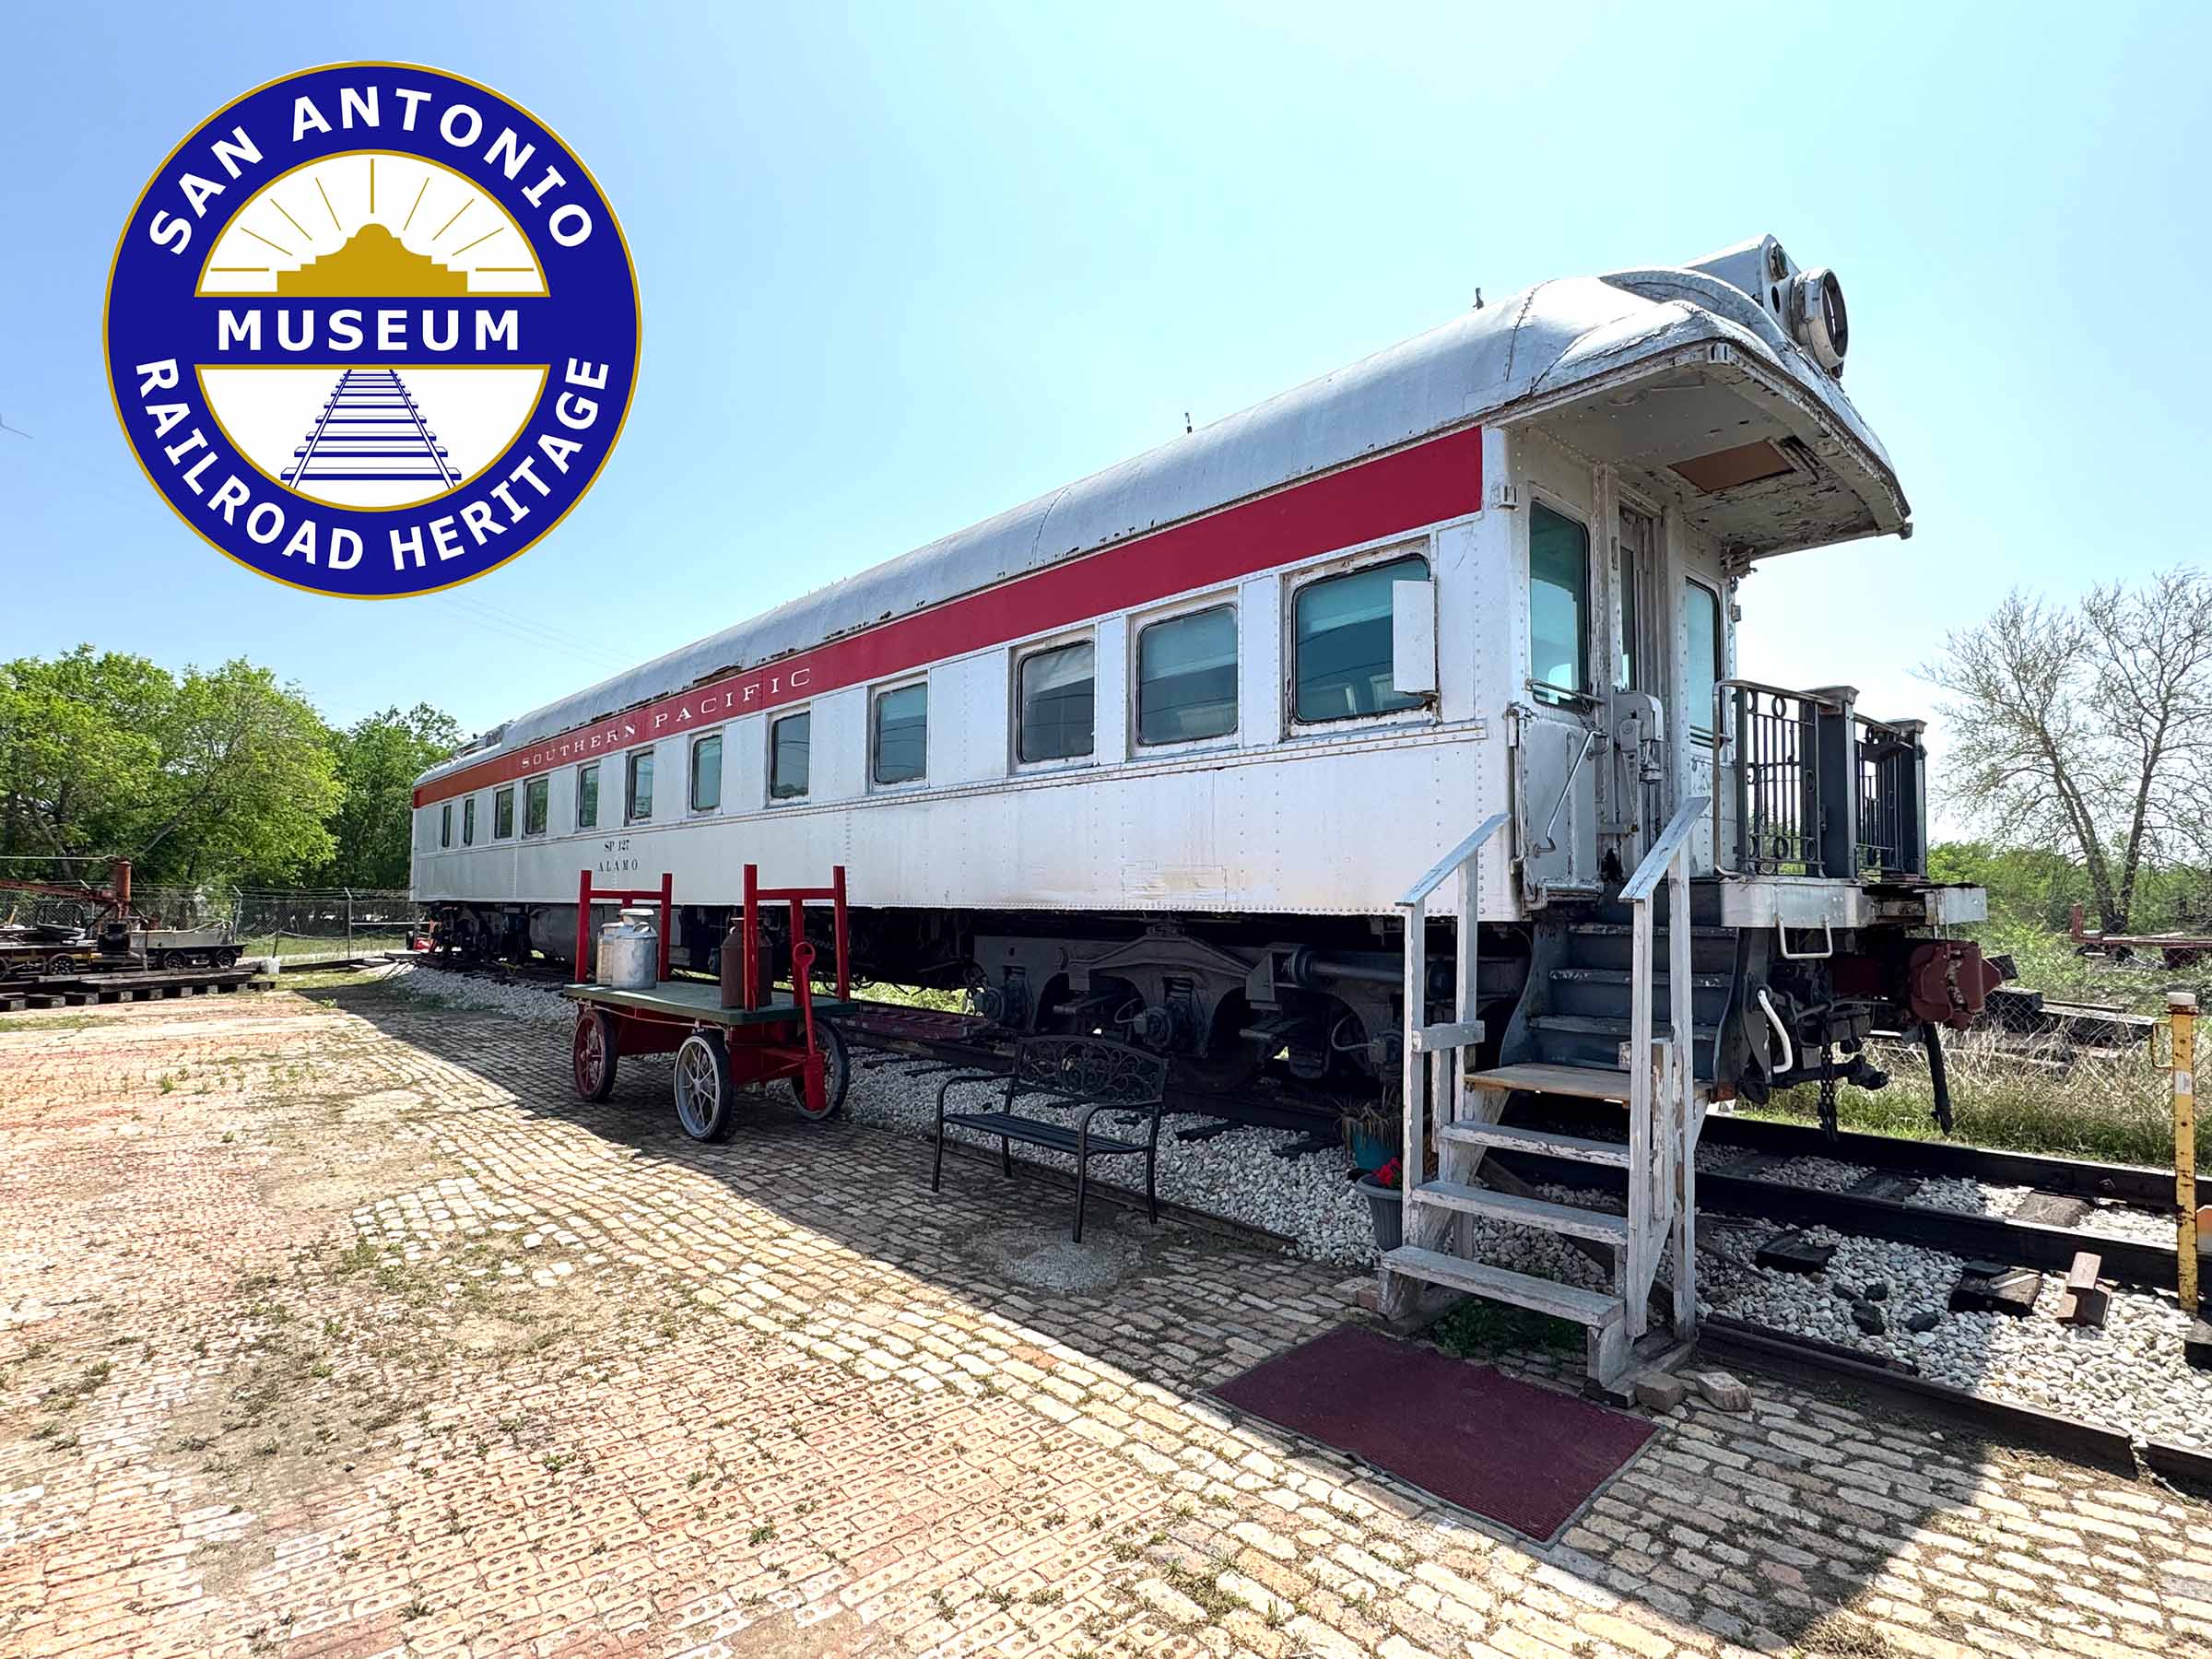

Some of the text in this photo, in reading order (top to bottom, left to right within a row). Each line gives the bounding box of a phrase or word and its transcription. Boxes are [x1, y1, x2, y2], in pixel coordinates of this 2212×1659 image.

[521, 667, 811, 769] SOUTHERN PACIFIC
[604, 840, 615, 852] SP
[597, 859, 639, 872] ALAMO
